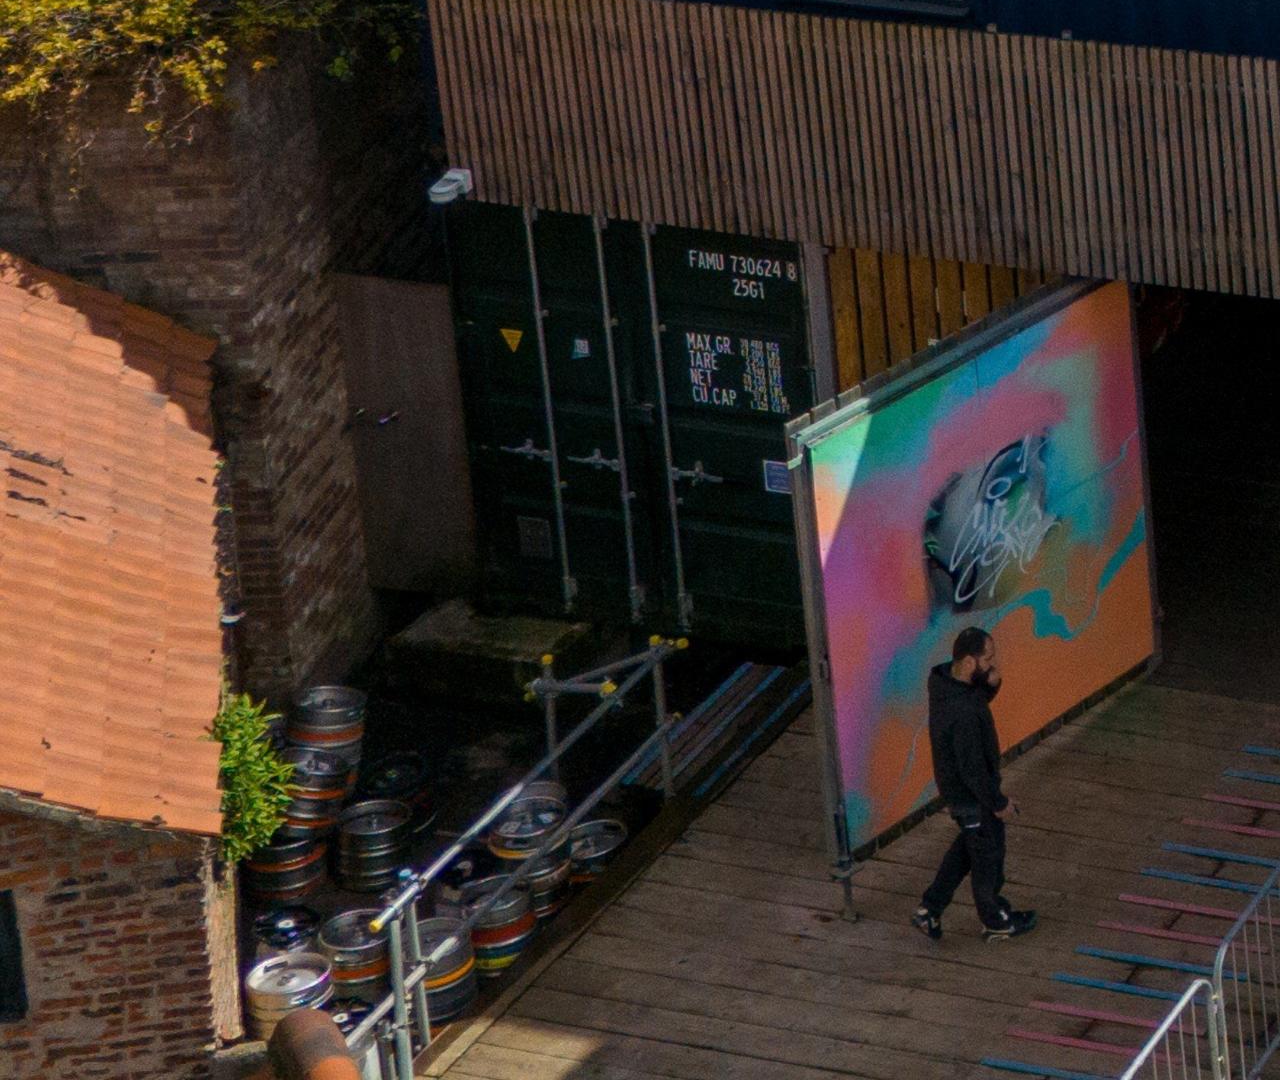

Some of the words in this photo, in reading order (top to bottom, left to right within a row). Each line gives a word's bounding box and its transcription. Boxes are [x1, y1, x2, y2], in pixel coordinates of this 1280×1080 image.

[688, 249, 725, 271] FAMU
[730, 255, 782, 278] 730624
[786, 262, 798, 282] 8
[732, 278, 765, 300] 25G1
[689, 351, 720, 371] TARE
[690, 368, 712, 387] NET
